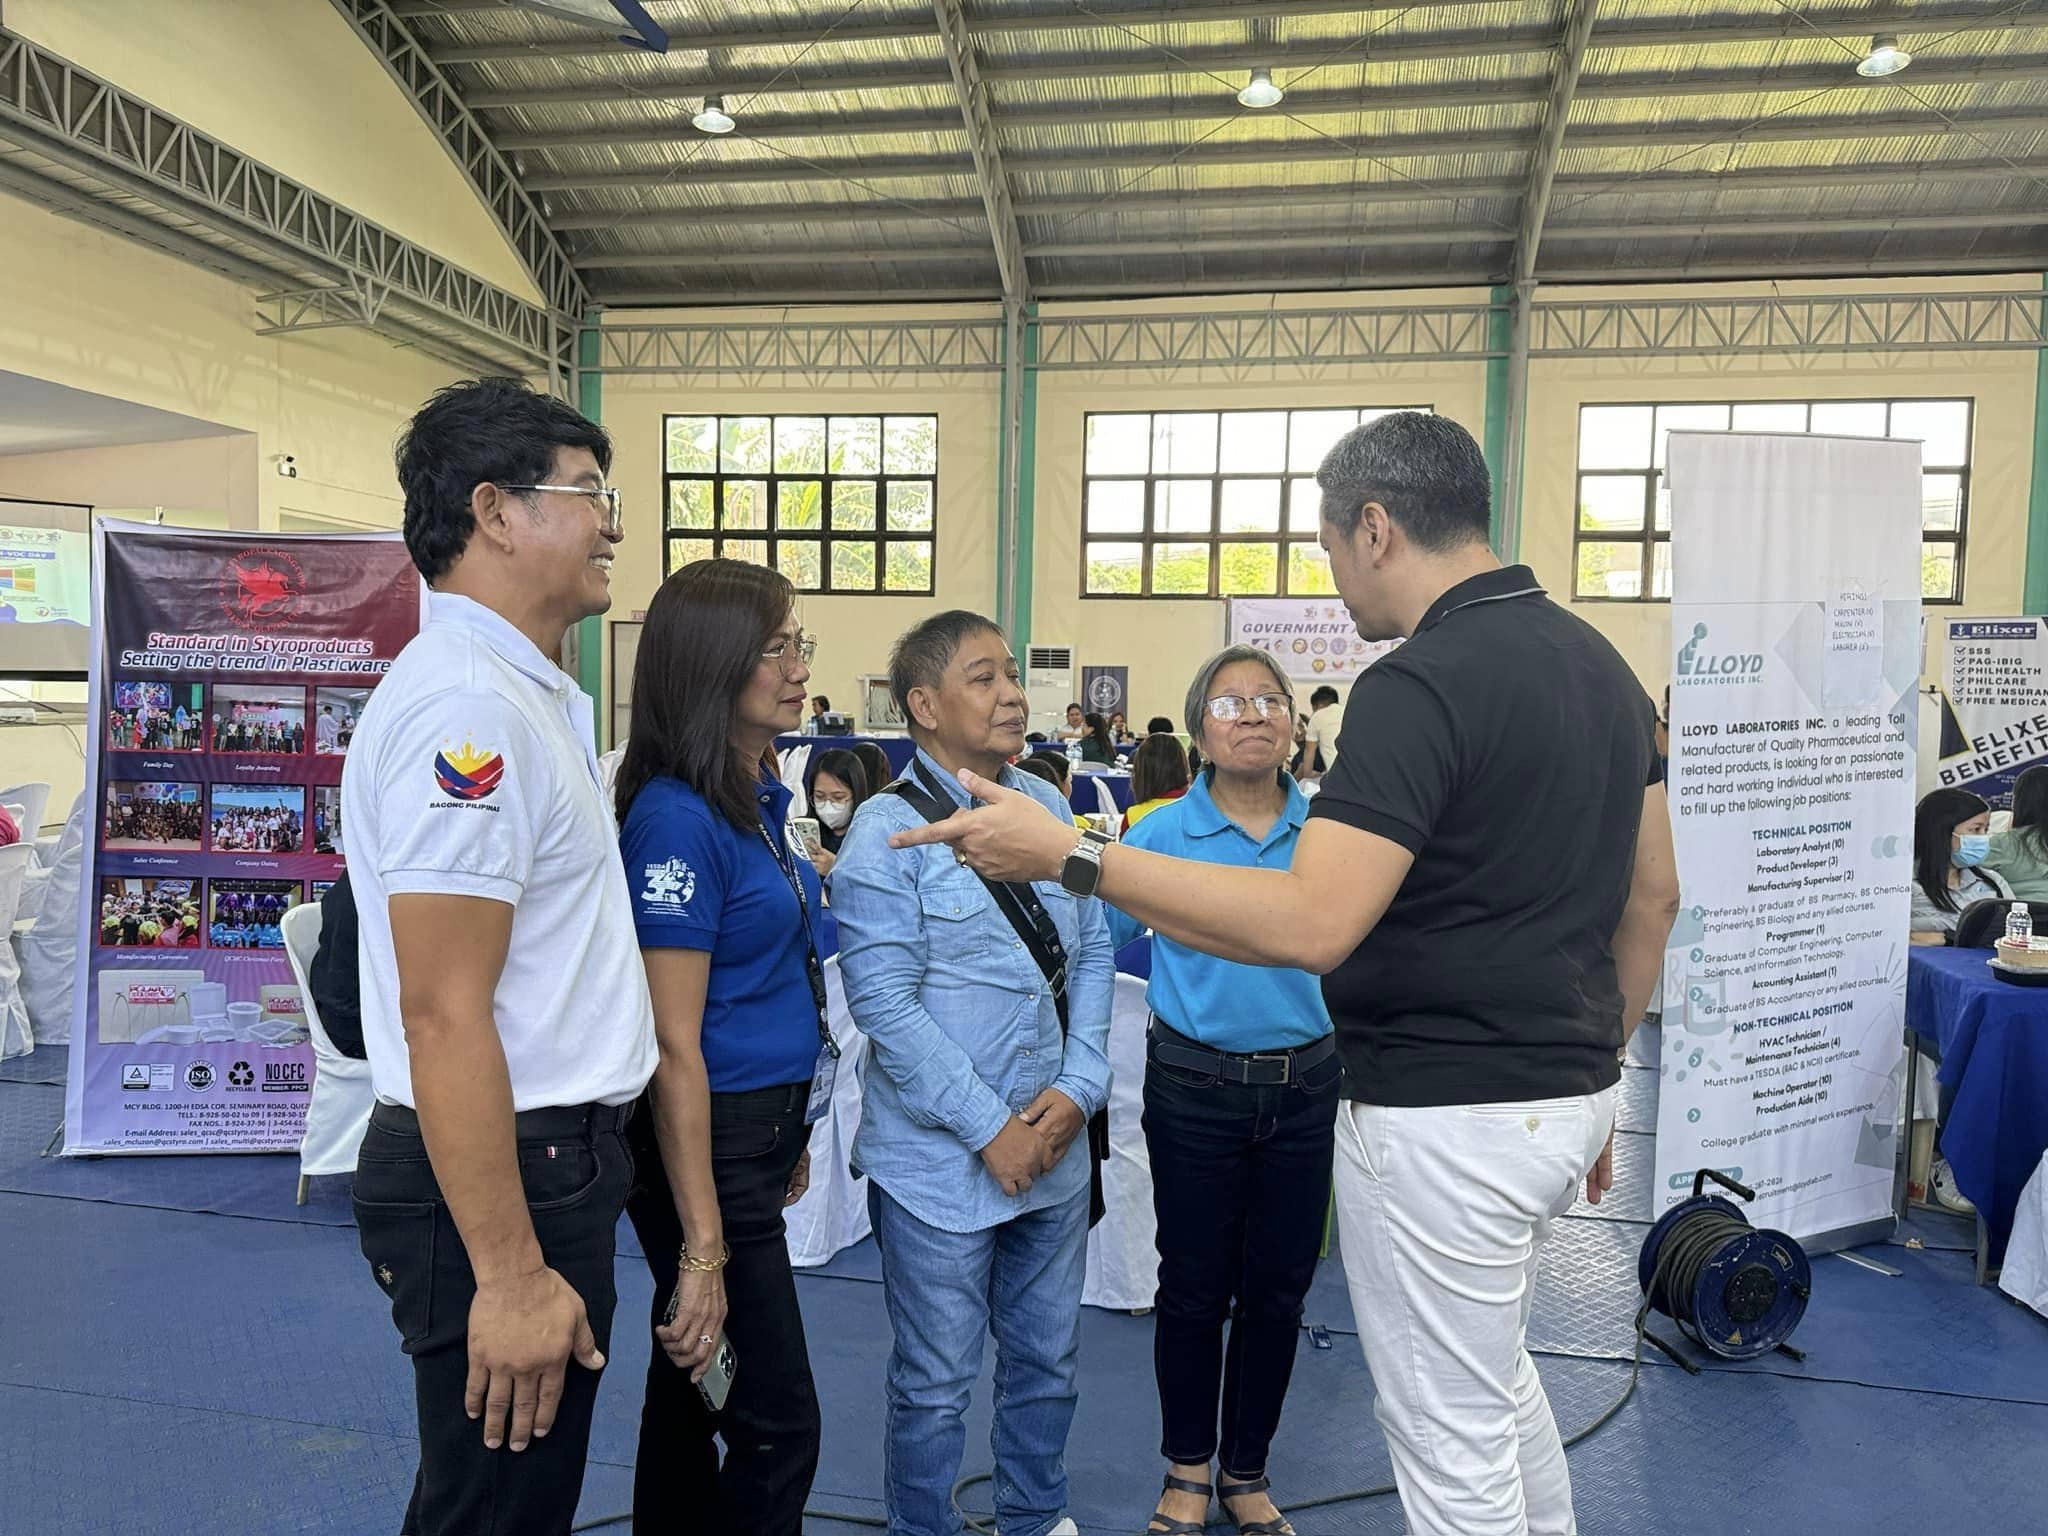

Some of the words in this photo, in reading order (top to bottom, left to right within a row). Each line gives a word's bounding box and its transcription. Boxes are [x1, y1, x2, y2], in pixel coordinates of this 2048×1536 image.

[1242, 623, 1349, 634] GOVERNMENT
[1971, 626, 2035, 634] Elixer
[148, 634, 226, 650] Standard
[232, 636, 247, 650] in
[252, 636, 372, 655] Styroproducts
[122, 652, 180, 669] Setting
[186, 654, 214, 669] the
[220, 654, 265, 670] trend
[271, 655, 286, 670] in
[292, 657, 391, 673] Plasticware
[1694, 655, 1763, 675] LLOYD
[1677, 677, 1744, 686] LABORATORIES
[1682, 726, 1718, 736] LLOYD
[1727, 720, 1799, 735] LABORATORIES
[1806, 719, 1827, 729] INC.
[1845, 715, 1881, 728] leading
[1888, 714, 1904, 724] Toll
[1682, 742, 1755, 756] Manufacturer
[1757, 741, 1766, 752] of
[1771, 739, 1804, 753] Quality
[1808, 733, 1881, 748] Pharmaceutical
[1884, 732, 1904, 742] and
[1681, 765, 1722, 776] related
[1725, 761, 1771, 777] products,
[1774, 759, 1782, 769] is
[1786, 755, 1817, 769] looking
[1820, 755, 1832, 766] for
[1835, 756, 1846, 765] an
[1850, 751, 1904, 766] passionate
[1681, 783, 1703, 795] and
[1707, 781, 1733, 794] hard
[1737, 777, 1774, 792] working
[1777, 773, 1822, 788] individual
[1825, 772, 1843, 784] who
[1845, 771, 1852, 782] is
[1855, 768, 1903, 782] interested
[465, 803, 500, 812] PILIPINAS
[1681, 804, 1691, 815] to
[1695, 802, 1707, 814] fill
[1711, 802, 1725, 816] up
[1729, 799, 1745, 812] the
[1748, 795, 1791, 810] following
[1792, 795, 1806, 809] job
[1809, 791, 1852, 807] positions:
[1752, 828, 1807, 840] TECHNICAL
[1809, 821, 1851, 834] POSITION
[1756, 845, 1800, 857] Laboratory
[1802, 841, 1831, 853] Analyst
[1832, 839, 1844, 849] (10)
[1757, 862, 1789, 874] Product
[1790, 859, 1827, 872] Developer
[1828, 856, 1838, 867] (3)
[1748, 880, 1801, 893] Manufacturing
[1804, 874, 1842, 886] Supervisor
[1844, 871, 1854, 881] (2)
[1703, 906, 1748, 918] Preferably
[1758, 899, 1794, 914] graduate
[1797, 896, 1804, 906] of
[1809, 896, 1818, 905] BS
[1861, 887, 1870, 896] BS
[1756, 916, 1765, 926] BS
[1767, 913, 1795, 926] Biology
[1796, 909, 1810, 921] and
[1813, 909, 1825, 919] any
[1827, 904, 1844, 916] allied
[1845, 903, 1875, 913] courses.
[1766, 928, 1814, 942] Programmer
[1816, 924, 1824, 935] (1)
[1704, 952, 1747, 963] Graduate
[1758, 943, 1797, 956] Computer
[1845, 929, 1883, 942] Computer
[1704, 966, 1742, 978] Science,
[1744, 964, 1756, 973] and
[1758, 956, 1802, 969] Information
[1752, 973, 1793, 989] Accounting
[1795, 969, 1827, 982] Assistant
[1828, 967, 1836, 977] (1)
[1705, 1001, 1747, 1014] Graduate
[1748, 999, 1755, 1008] of
[1756, 997, 1765, 1007] BS
[1767, 987, 1815, 1005] Accountancy
[1817, 987, 1824, 996] or
[1826, 984, 1838, 994] any
[1840, 980, 1856, 990] allied
[1858, 975, 1889, 987] courses.
[1733, 1007, 1811, 1033] NON-TECHNICAL
[1813, 1000, 1853, 1017] POSITION
[1760, 1038, 1785, 1048] HVAC
[1786, 1030, 1821, 1044] Technician
[1745, 1048, 1792, 1065] Maintenance
[1793, 1041, 1829, 1055] Technician
[1831, 1037, 1840, 1048] (4)
[191, 1071, 210, 1079] ISO
[266, 1064, 280, 1079] NO
[283, 1064, 305, 1079] CFC
[1704, 1077, 1728, 1087] Must
[1730, 1074, 1748, 1084] have
[1756, 1068, 1781, 1079] TESDA
[1782, 1063, 1799, 1075] (RAC
[1753, 1086, 1784, 1099] Machine
[1786, 1079, 1818, 1094] Operator
[1819, 1074, 1832, 1087] (10)
[1756, 1101, 1796, 1116] Production
[1798, 1095, 1813, 1107] Aide
[1815, 1091, 1827, 1103] (10)
[1701, 1135, 1738, 1148] College
[1739, 1128, 1772, 1145] graduate
[1774, 1124, 1789, 1135] with
[1790, 1117, 1817, 1130] minimal
[1818, 1112, 1834, 1124] work
[1836, 1103, 1875, 1119] experience.
